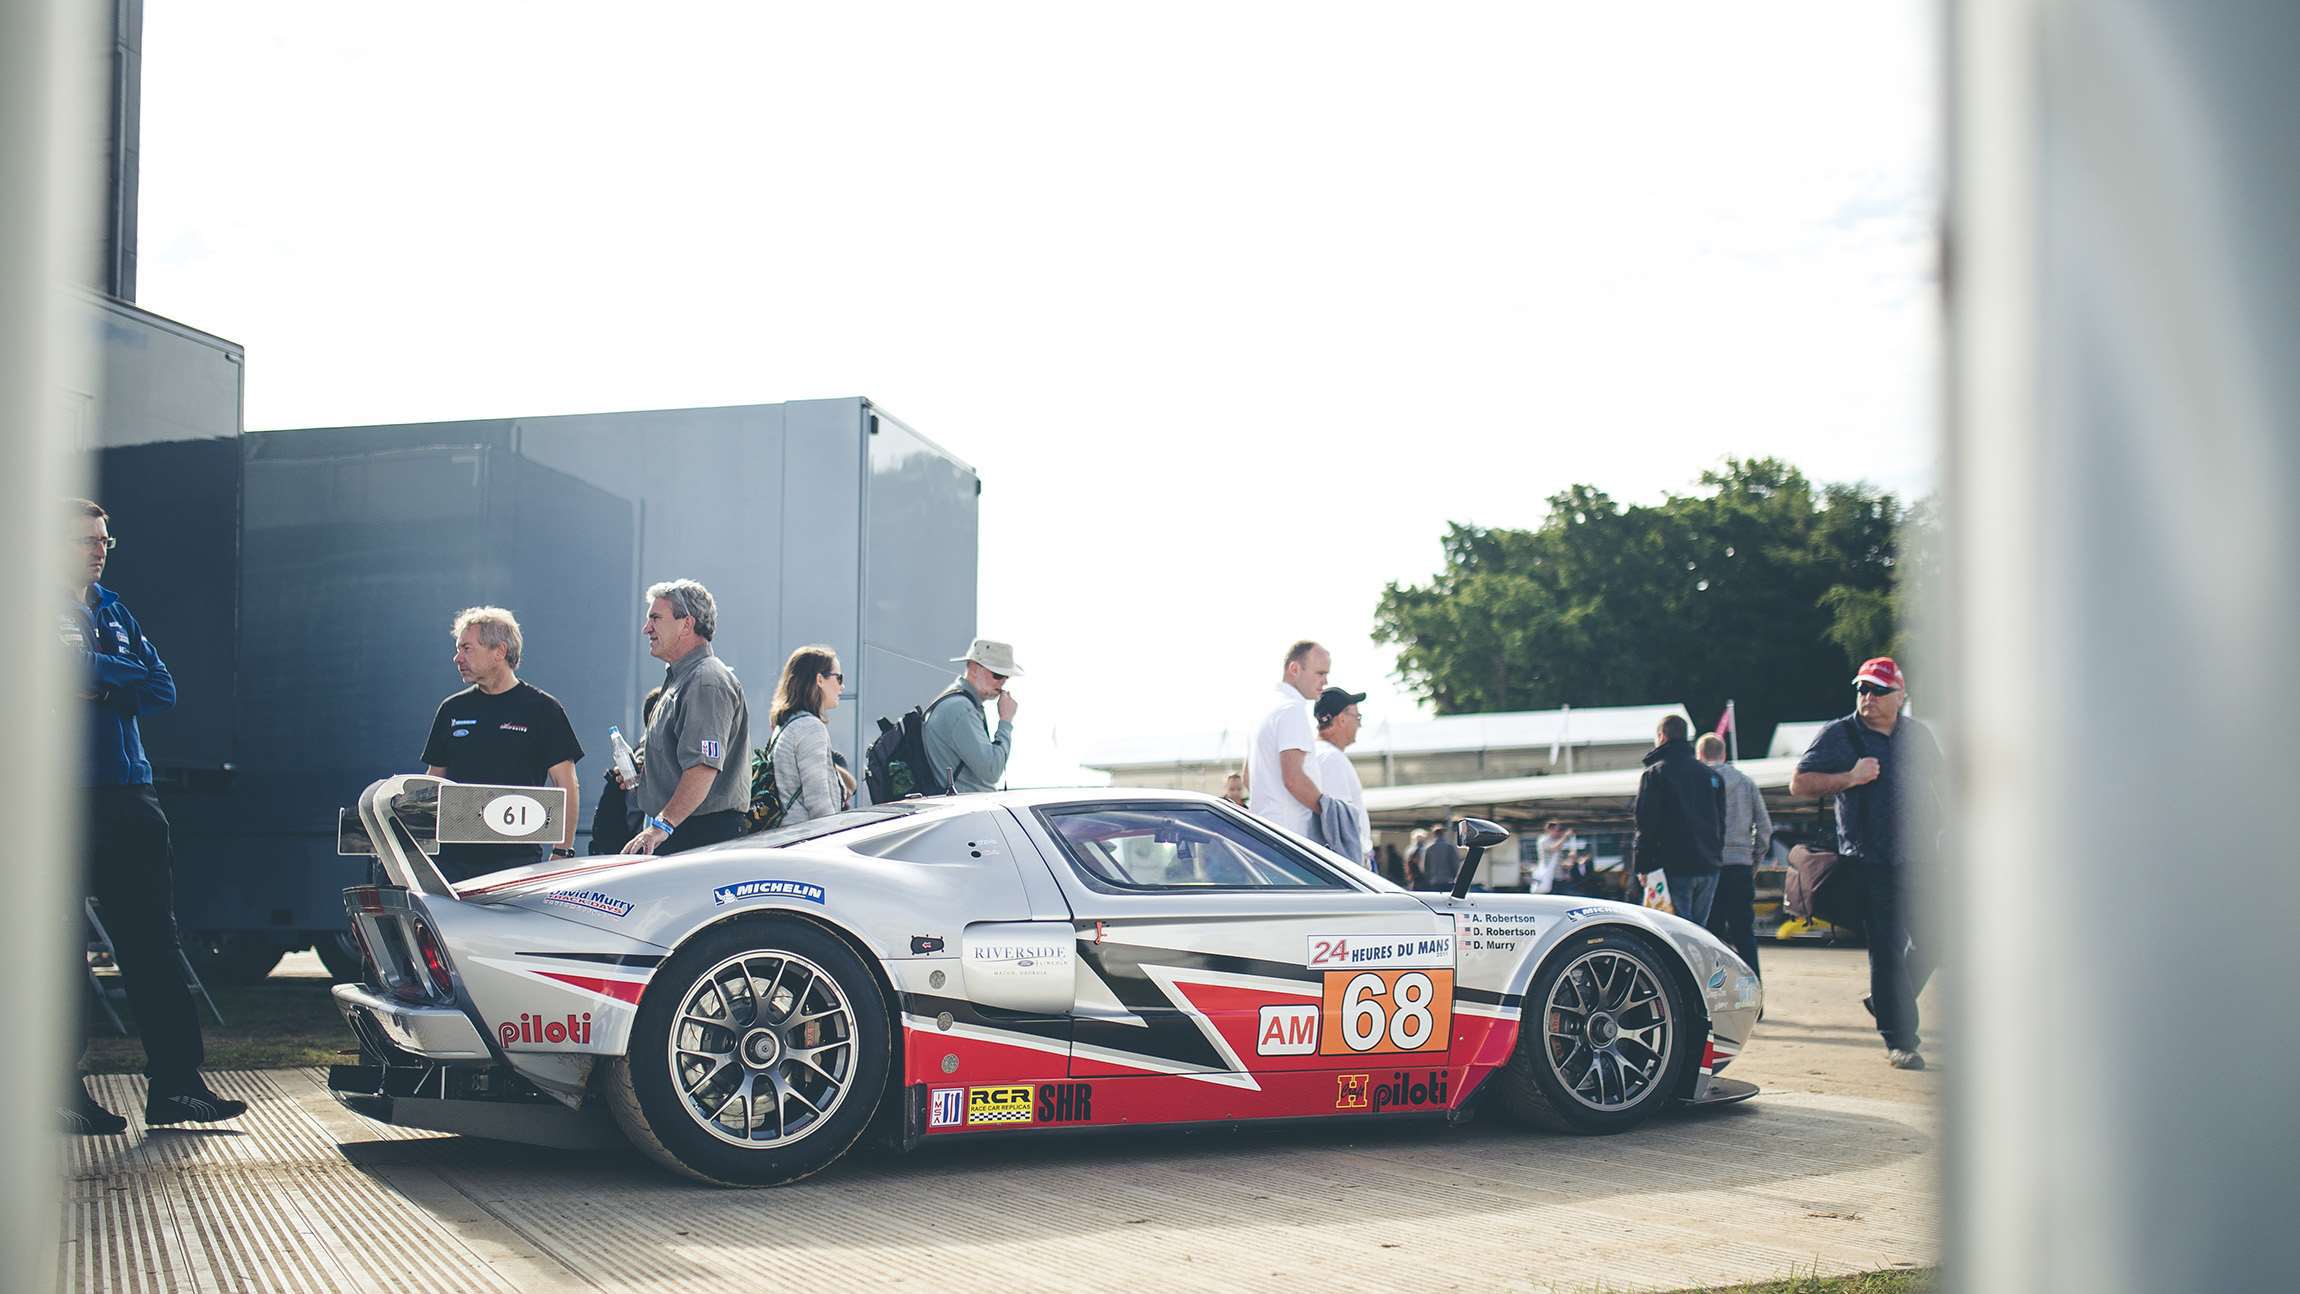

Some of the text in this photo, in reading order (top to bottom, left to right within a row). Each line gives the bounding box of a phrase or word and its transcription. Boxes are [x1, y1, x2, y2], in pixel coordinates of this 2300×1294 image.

[503, 806, 526, 826] 61
[736, 882, 822, 899] MICHELIN
[590, 891, 635, 912] Murry
[1472, 913, 1536, 923] A. Robertson
[1473, 927, 1537, 936] D. Robertson
[975, 946, 1066, 959] RIVERSIDE
[1311, 938, 1450, 965] 24 HEURES DU MANS
[1473, 940, 1516, 952] D. Murry
[1341, 972, 1434, 1052] 68
[498, 1012, 592, 1049] piloti
[1261, 1015, 1315, 1046] AM
[971, 1089, 1031, 1105] RCR
[1372, 1070, 1449, 1113] piloti
[934, 1093, 943, 1124] IMSA
[1038, 1083, 1093, 1122] SHR
